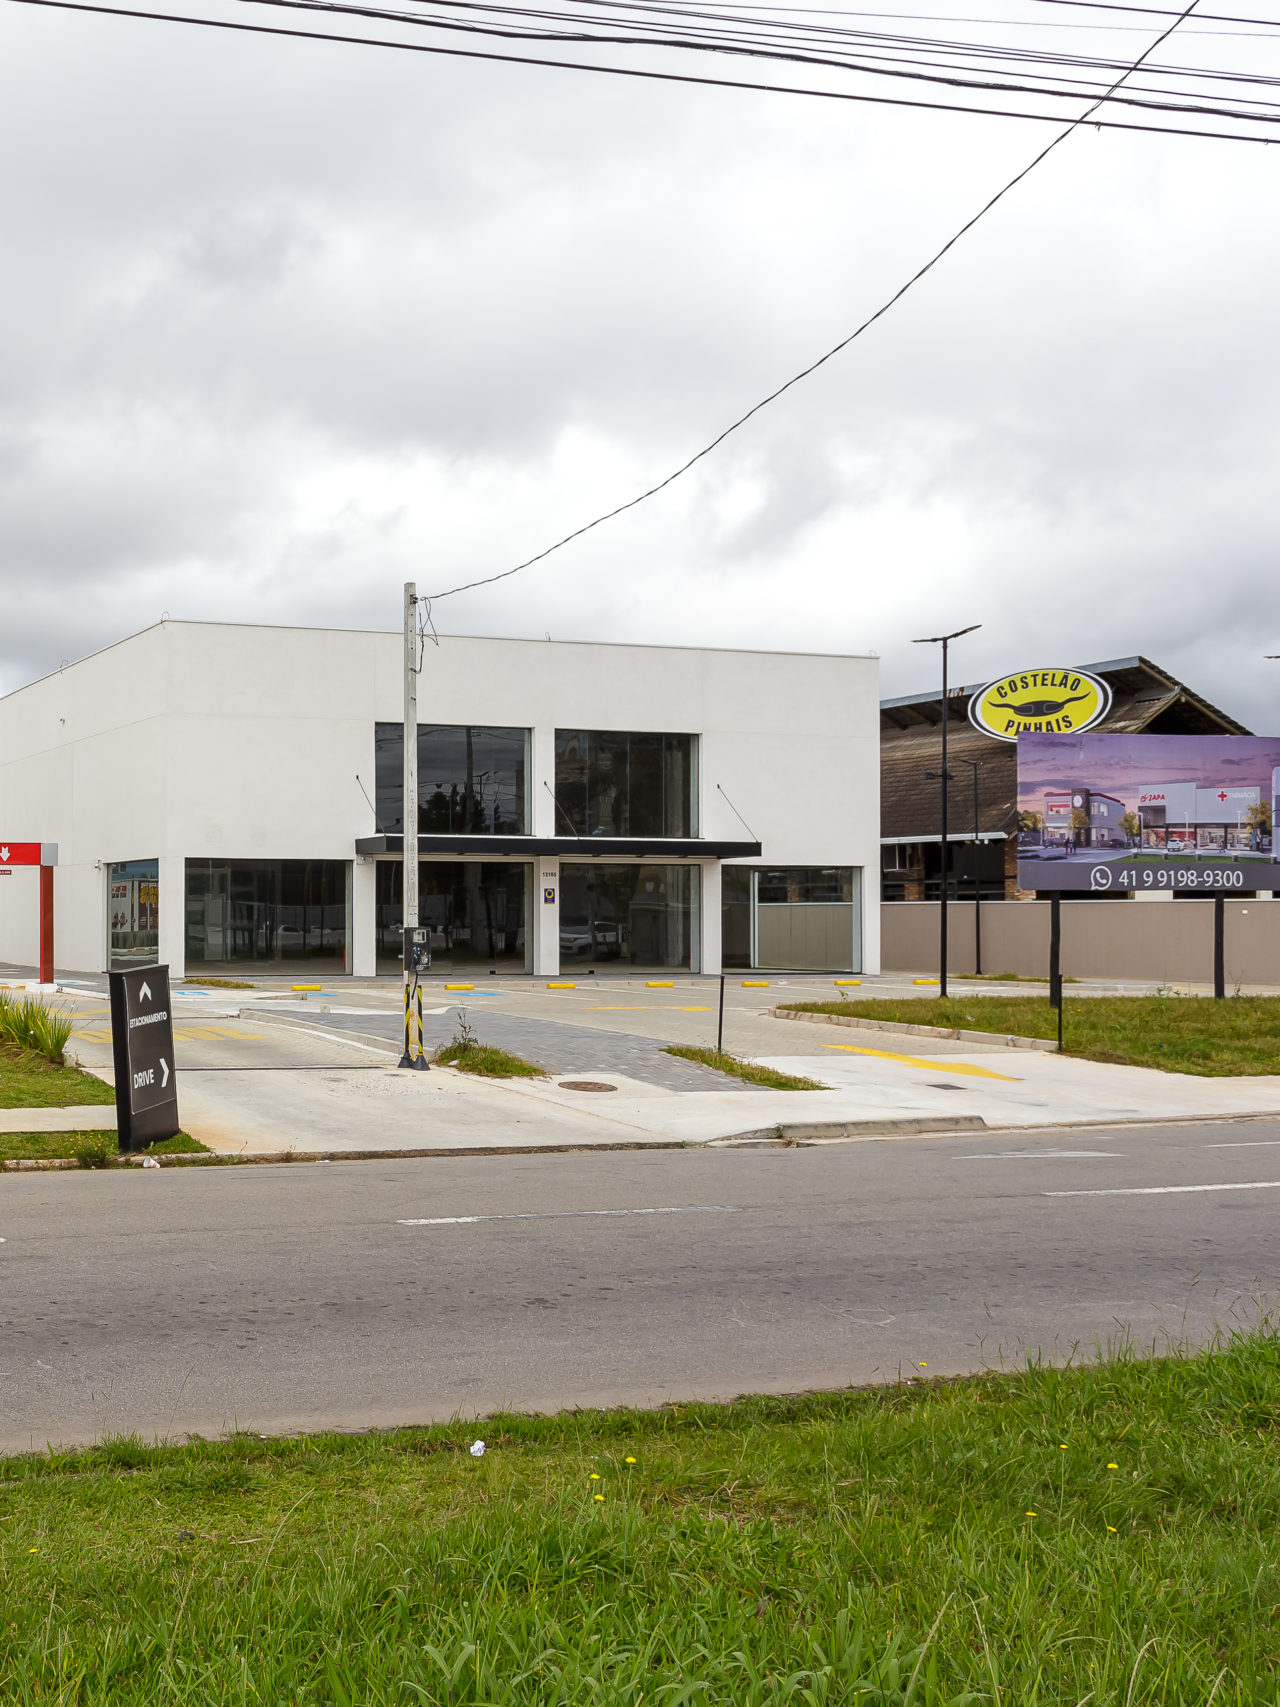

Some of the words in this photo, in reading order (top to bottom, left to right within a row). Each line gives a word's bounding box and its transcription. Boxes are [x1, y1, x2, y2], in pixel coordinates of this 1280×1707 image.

[996, 672, 1081, 699] COSTELÃO
[1004, 715, 1073, 736] PINHAIS
[1118, 871, 1137, 886] 41
[1143, 871, 1153, 886] 9
[1157, 871, 1243, 887] 9198-9300
[129, 1011, 167, 1028] ESTACIONAMENTO
[133, 1068, 155, 1089] DRIVE
